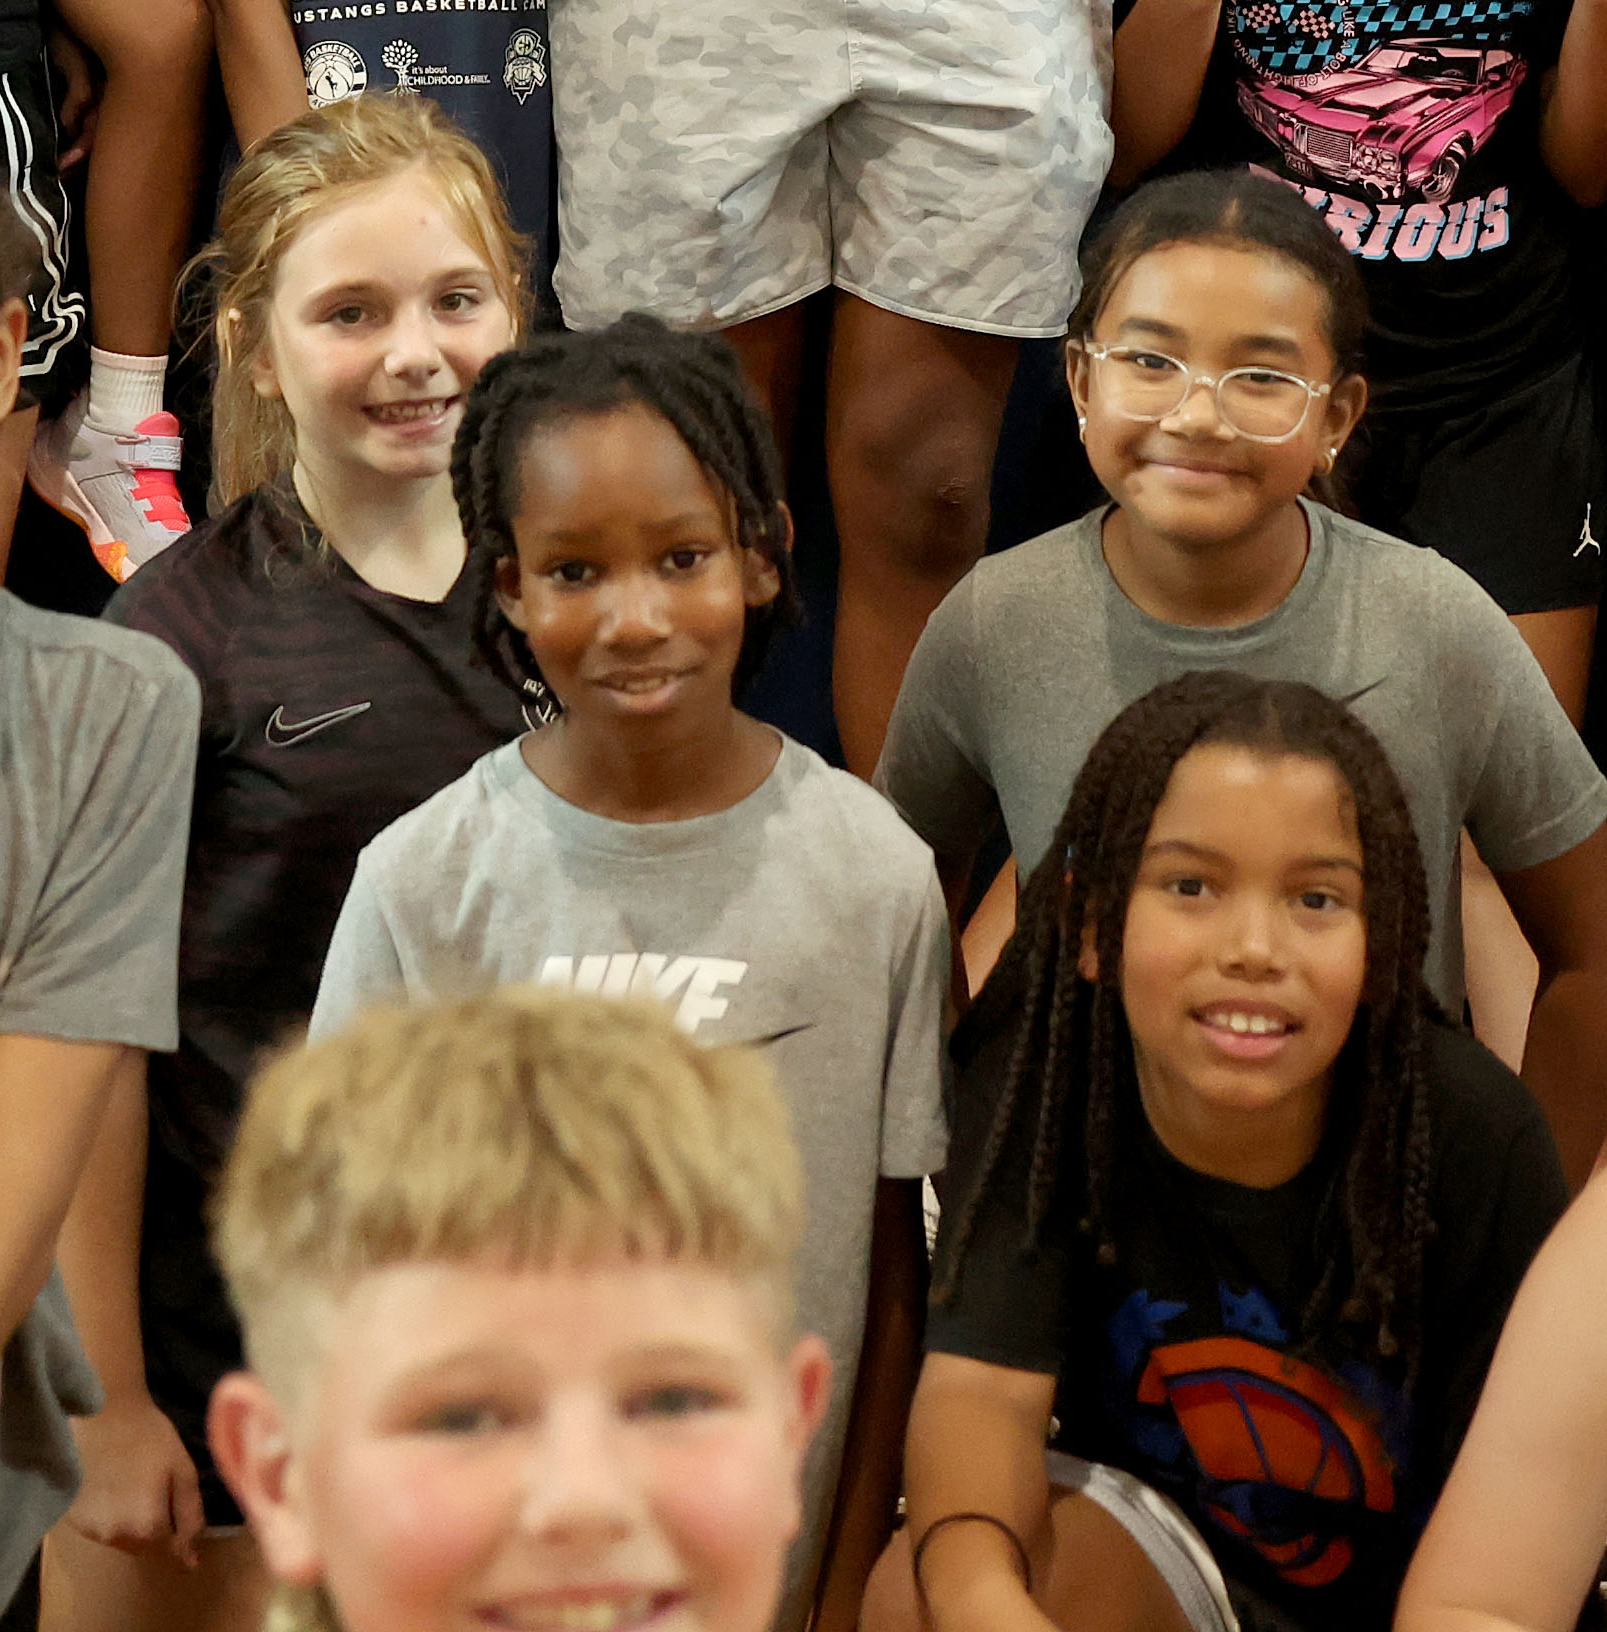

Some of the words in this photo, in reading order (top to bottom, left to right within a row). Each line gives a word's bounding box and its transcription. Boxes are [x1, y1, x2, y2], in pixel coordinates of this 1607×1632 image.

[294, 3, 386, 24] USTANGS
[1342, 9, 1355, 38] LIKE
[1340, 39, 1351, 50] A
[309, 44, 361, 68] BASKETBALL
[1320, 51, 1347, 81] BOLT
[407, 74, 463, 86] CHILDHOOD
[464, 74, 471, 85] &
[411, 65, 423, 75] it's
[424, 65, 448, 75] about
[1249, 162, 1510, 262] RIOUS
